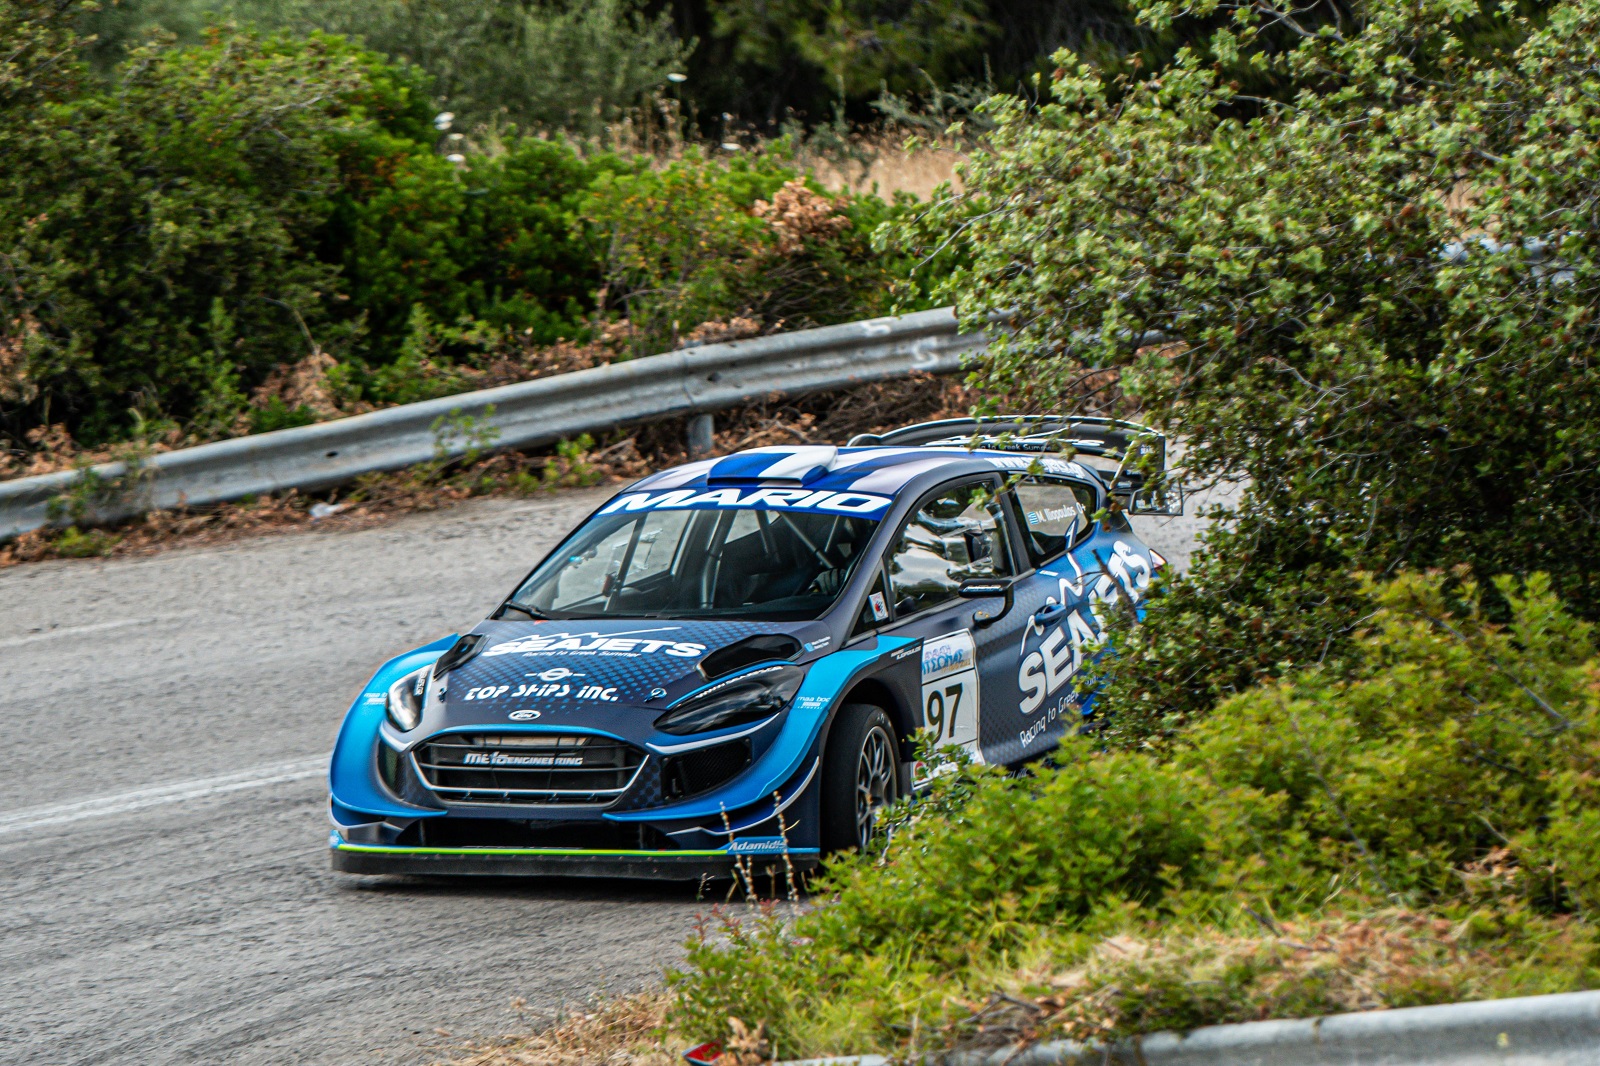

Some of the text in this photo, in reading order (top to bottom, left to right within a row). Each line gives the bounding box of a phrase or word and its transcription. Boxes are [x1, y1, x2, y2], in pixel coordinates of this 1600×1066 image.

[598, 488, 892, 515] MARIO
[481, 638, 707, 658] SEAJETS
[926, 682, 963, 744] 97
[1019, 715, 1046, 748] Racing
[1047, 707, 1056, 723] to
